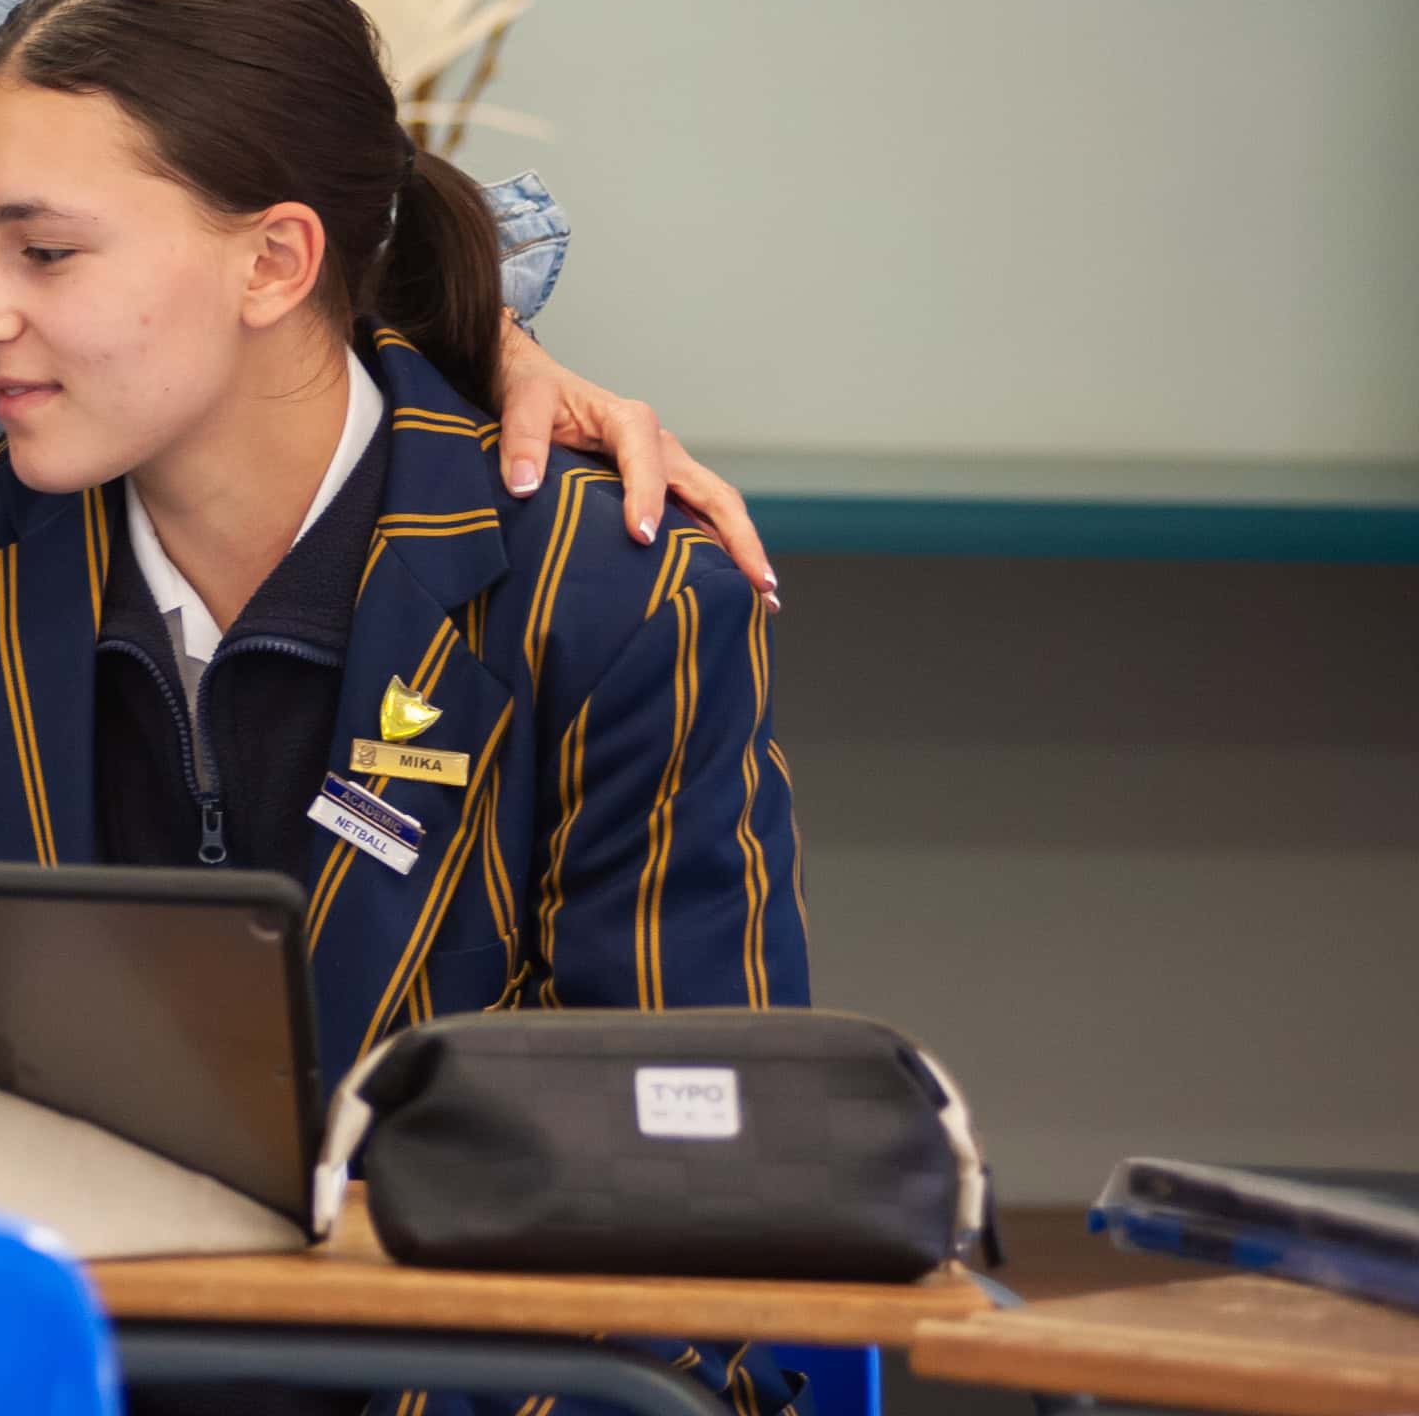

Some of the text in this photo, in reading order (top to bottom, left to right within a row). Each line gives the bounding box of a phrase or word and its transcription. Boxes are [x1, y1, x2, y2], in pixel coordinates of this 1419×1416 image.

[399, 754, 443, 773] MIKA
[341, 790, 404, 834] ACADEMIC
[334, 815, 388, 854] NETBALL
[650, 1083, 724, 1103] TYPO
